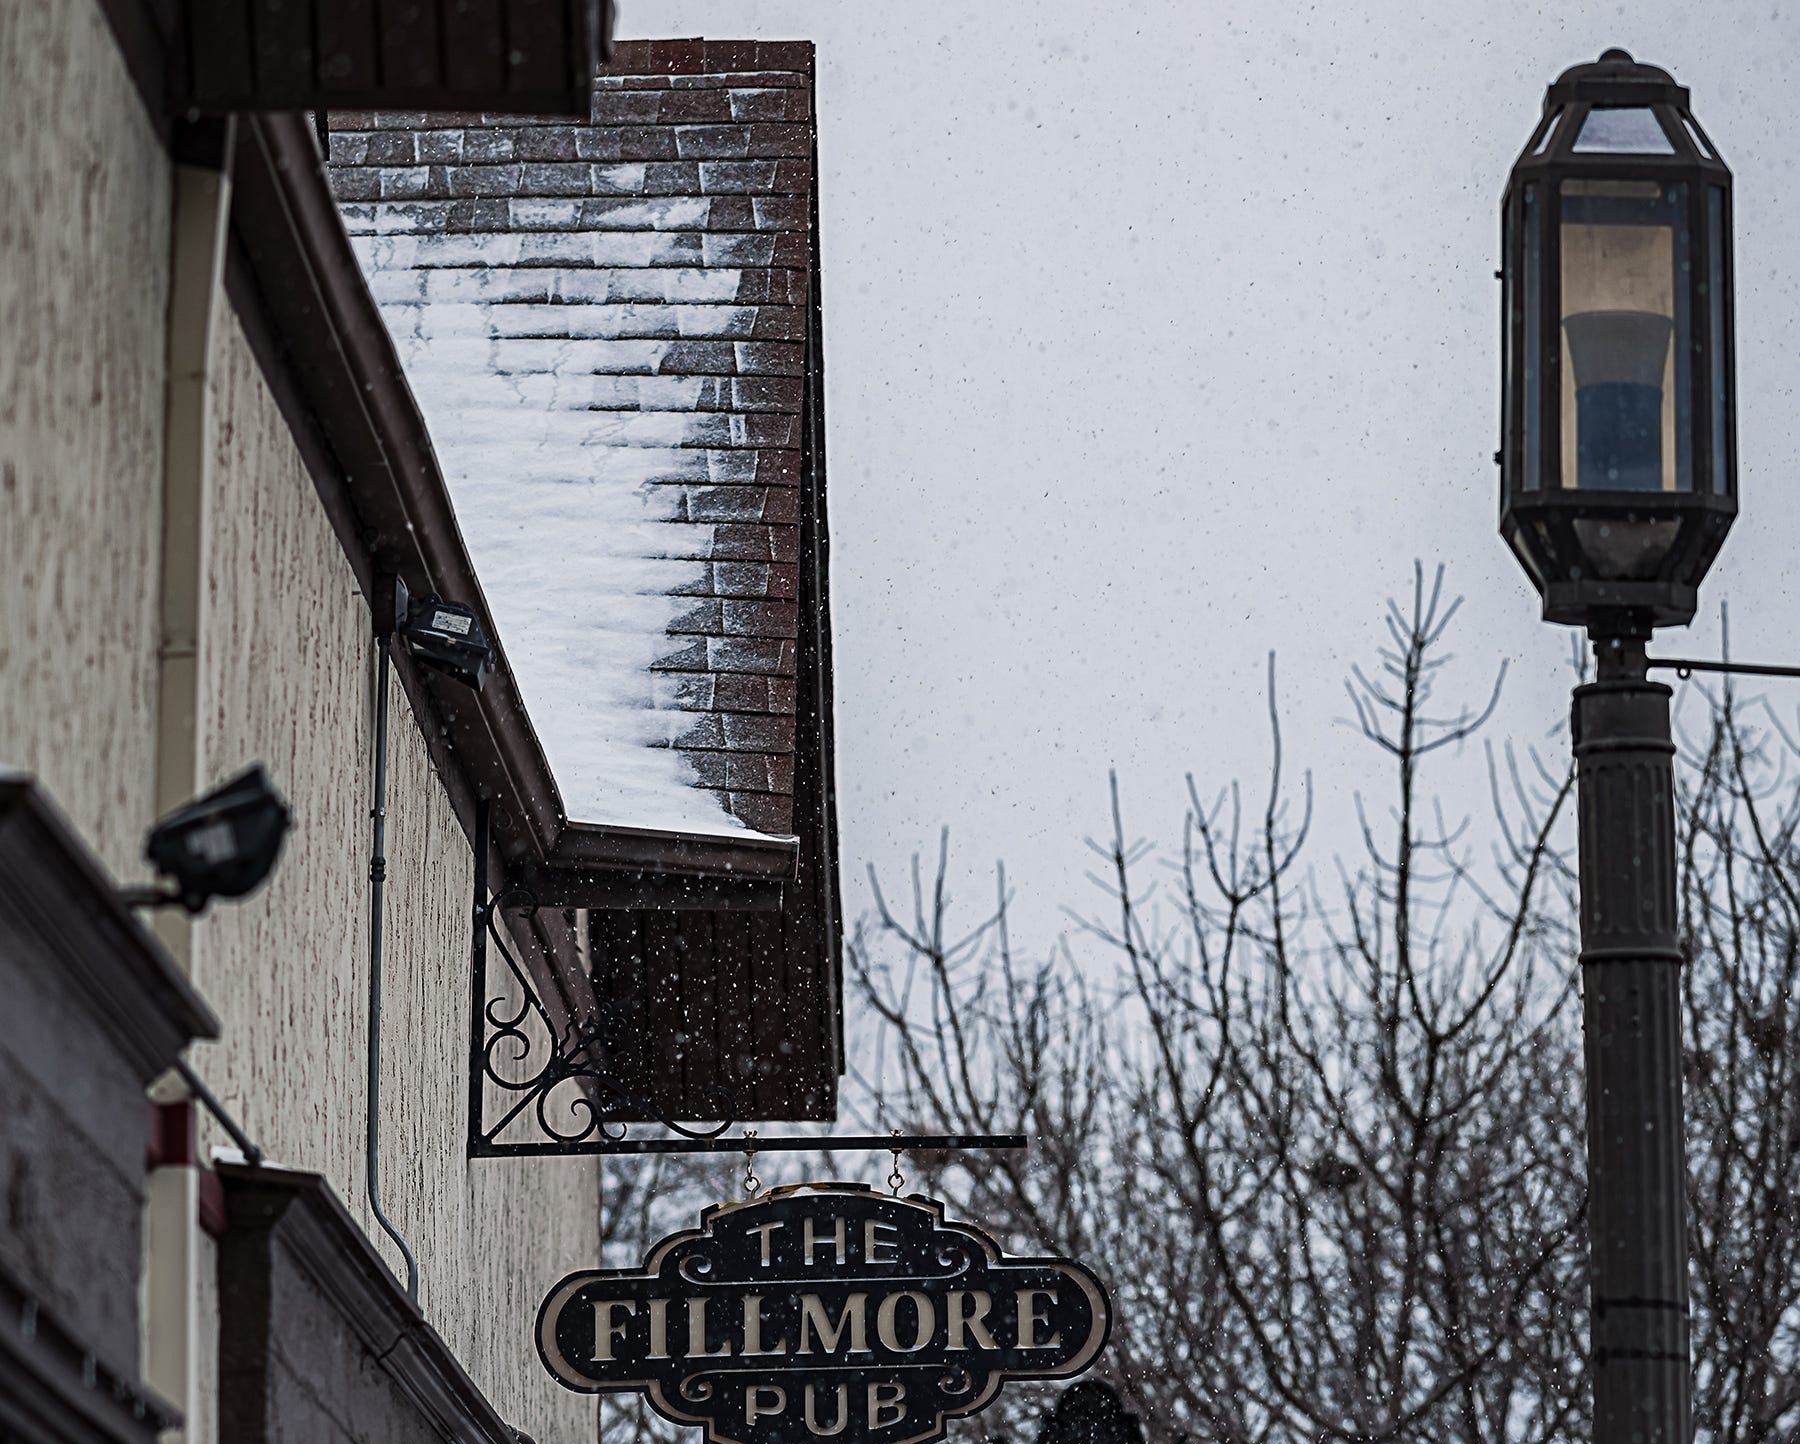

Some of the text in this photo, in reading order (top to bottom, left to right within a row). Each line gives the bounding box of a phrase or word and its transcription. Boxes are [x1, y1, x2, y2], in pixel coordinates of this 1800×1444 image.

[745, 1216, 899, 1268] THE
[590, 1287, 1062, 1363] FILLMORE
[746, 1381, 908, 1437] PUB
